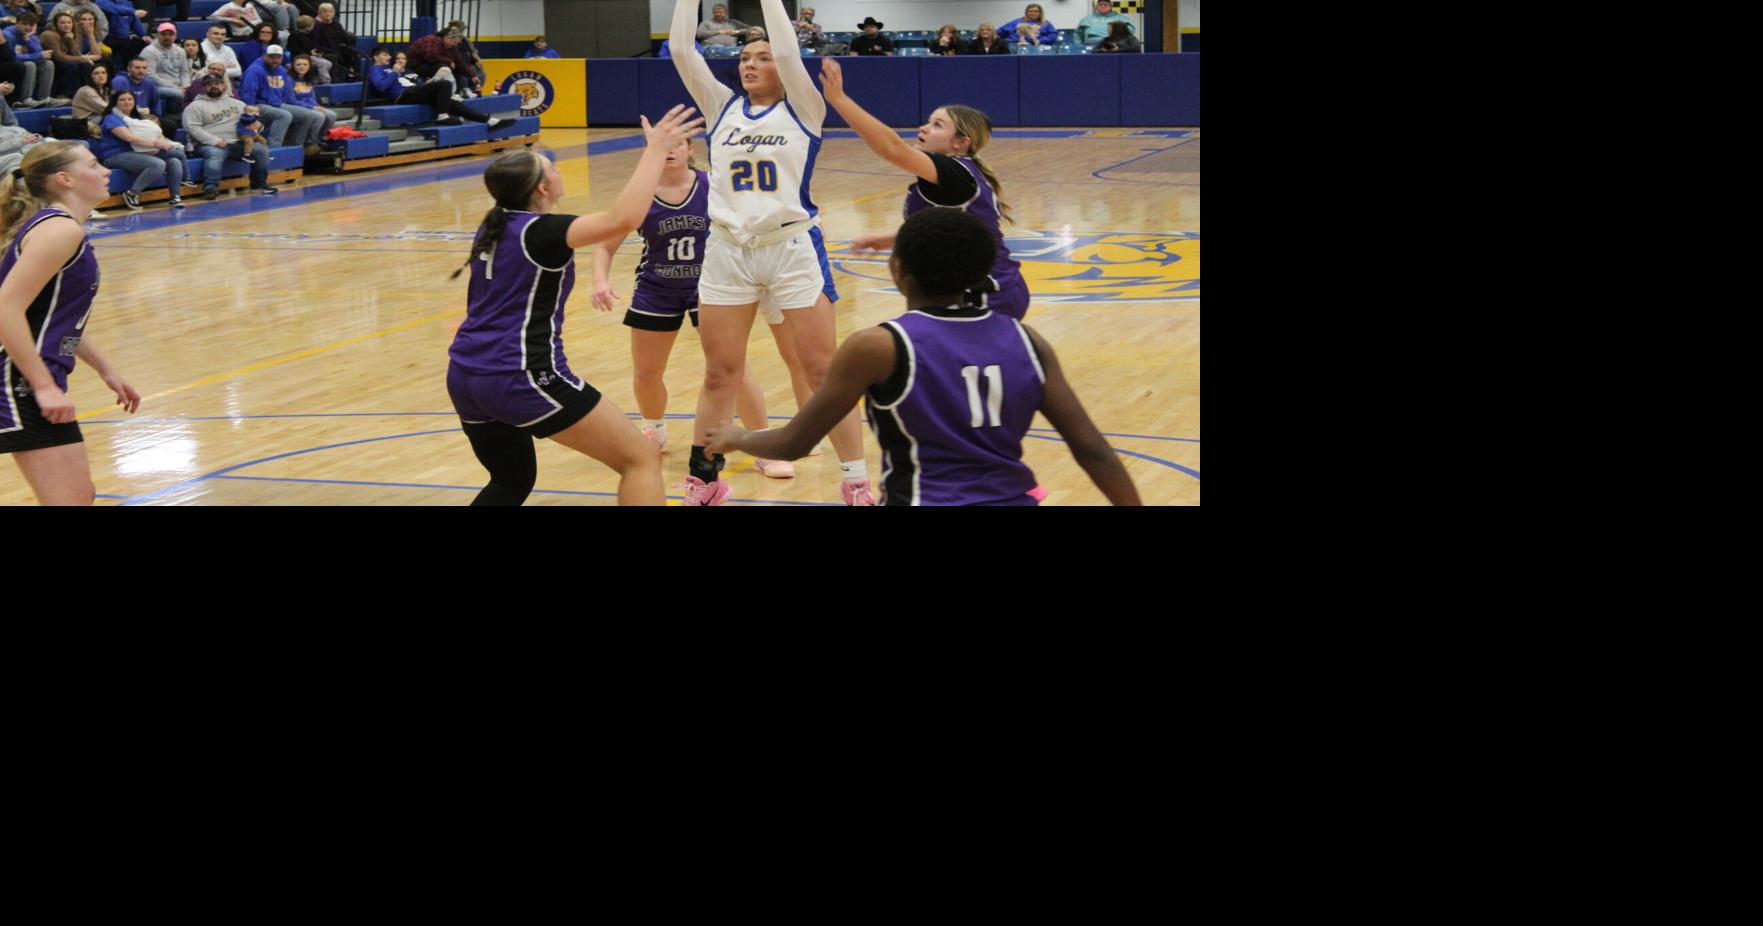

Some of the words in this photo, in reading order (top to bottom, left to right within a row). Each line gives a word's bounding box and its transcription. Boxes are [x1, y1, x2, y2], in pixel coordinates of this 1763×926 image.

[722, 127, 788, 153] Logan
[729, 159, 778, 192] 20
[658, 215, 706, 235] JAMES
[667, 236, 696, 261] 10
[654, 263, 703, 279] MONRO
[961, 364, 1003, 428] 11
